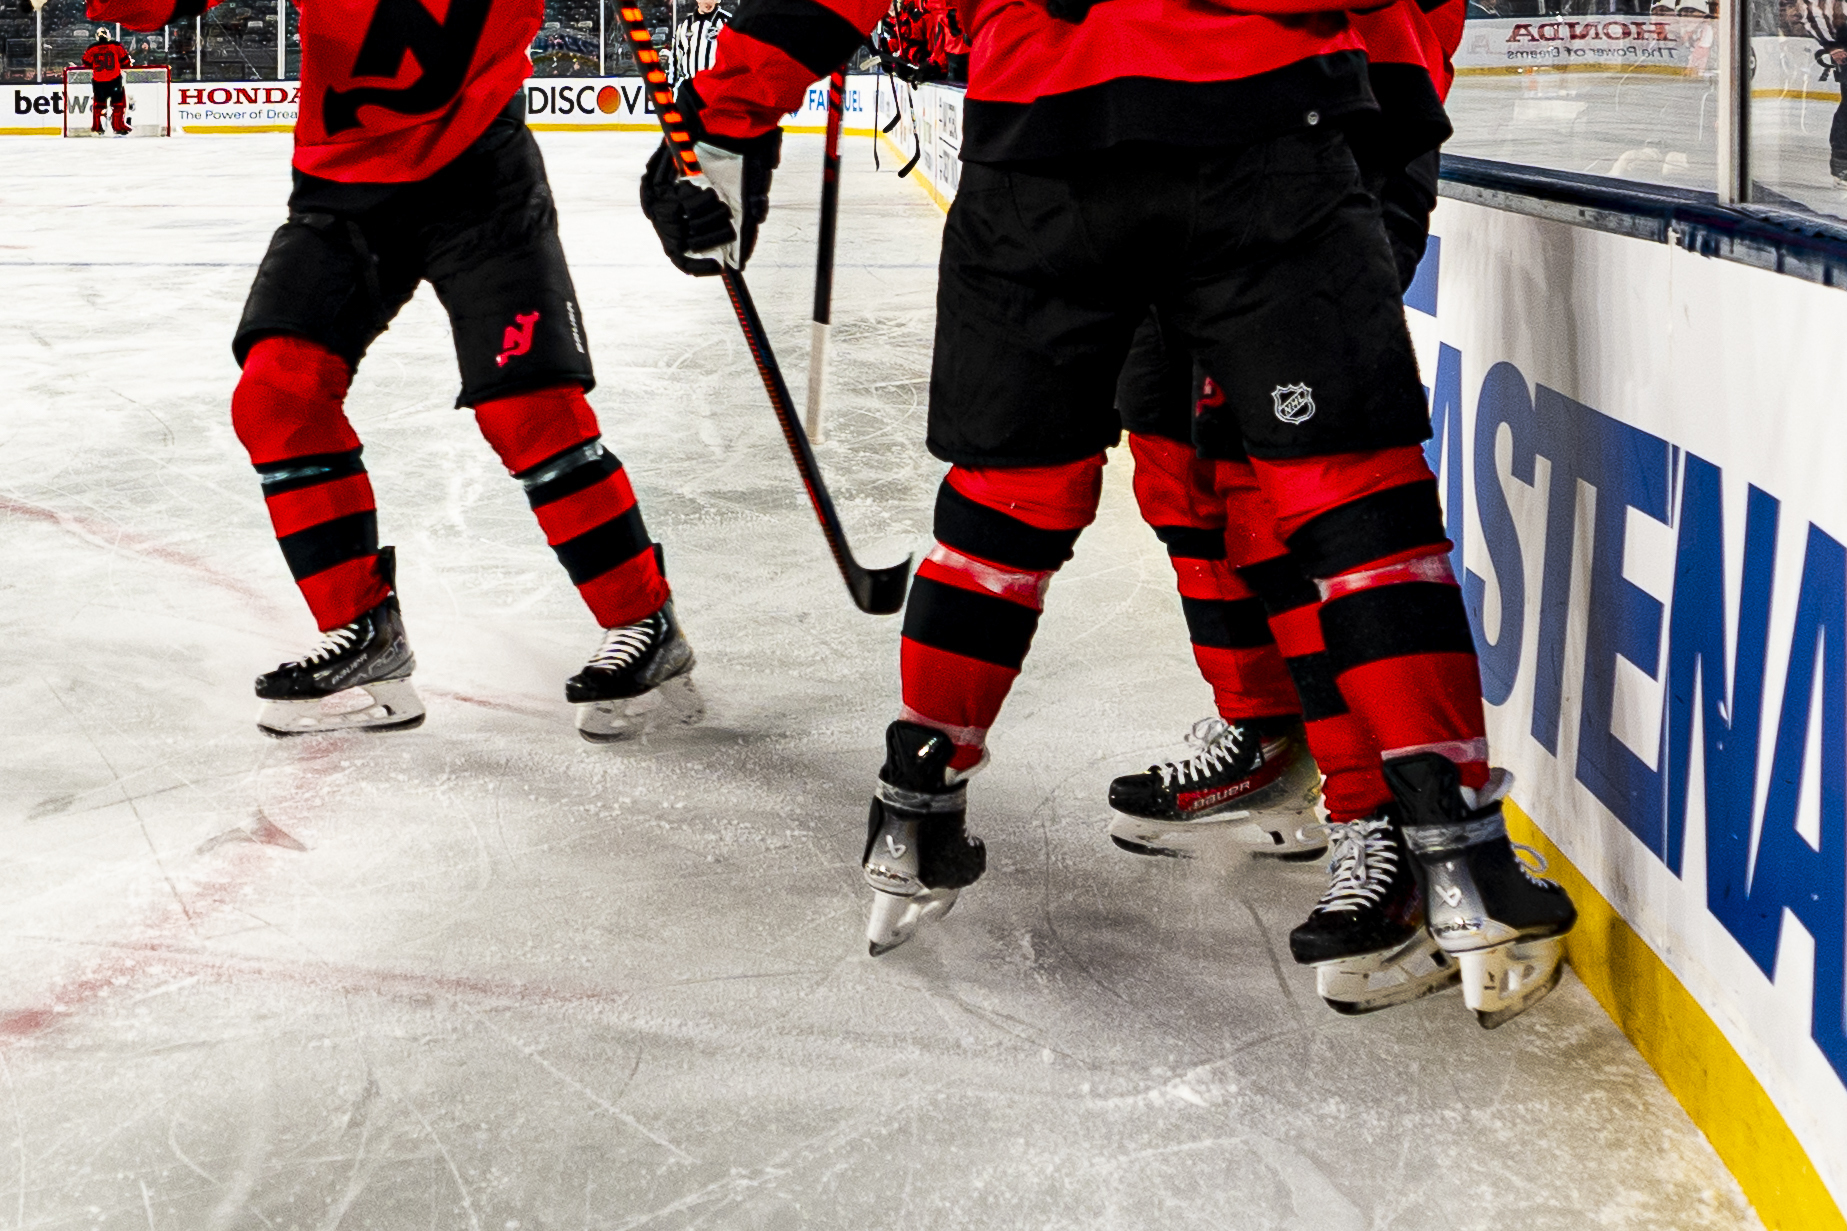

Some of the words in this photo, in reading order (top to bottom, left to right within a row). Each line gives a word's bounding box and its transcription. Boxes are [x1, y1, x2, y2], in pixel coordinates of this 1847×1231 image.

[94, 52, 115, 72] 50
[179, 110, 195, 120] The
[205, 109, 246, 120] Power
[248, 108, 264, 119] of
[266, 108, 299, 120] Drea
[526, 85, 656, 116] DISCOV
[808, 89, 864, 113] FAUEL
[1404, 234, 1847, 1093] ASTENA
[1191, 780, 1252, 811] BAUER
